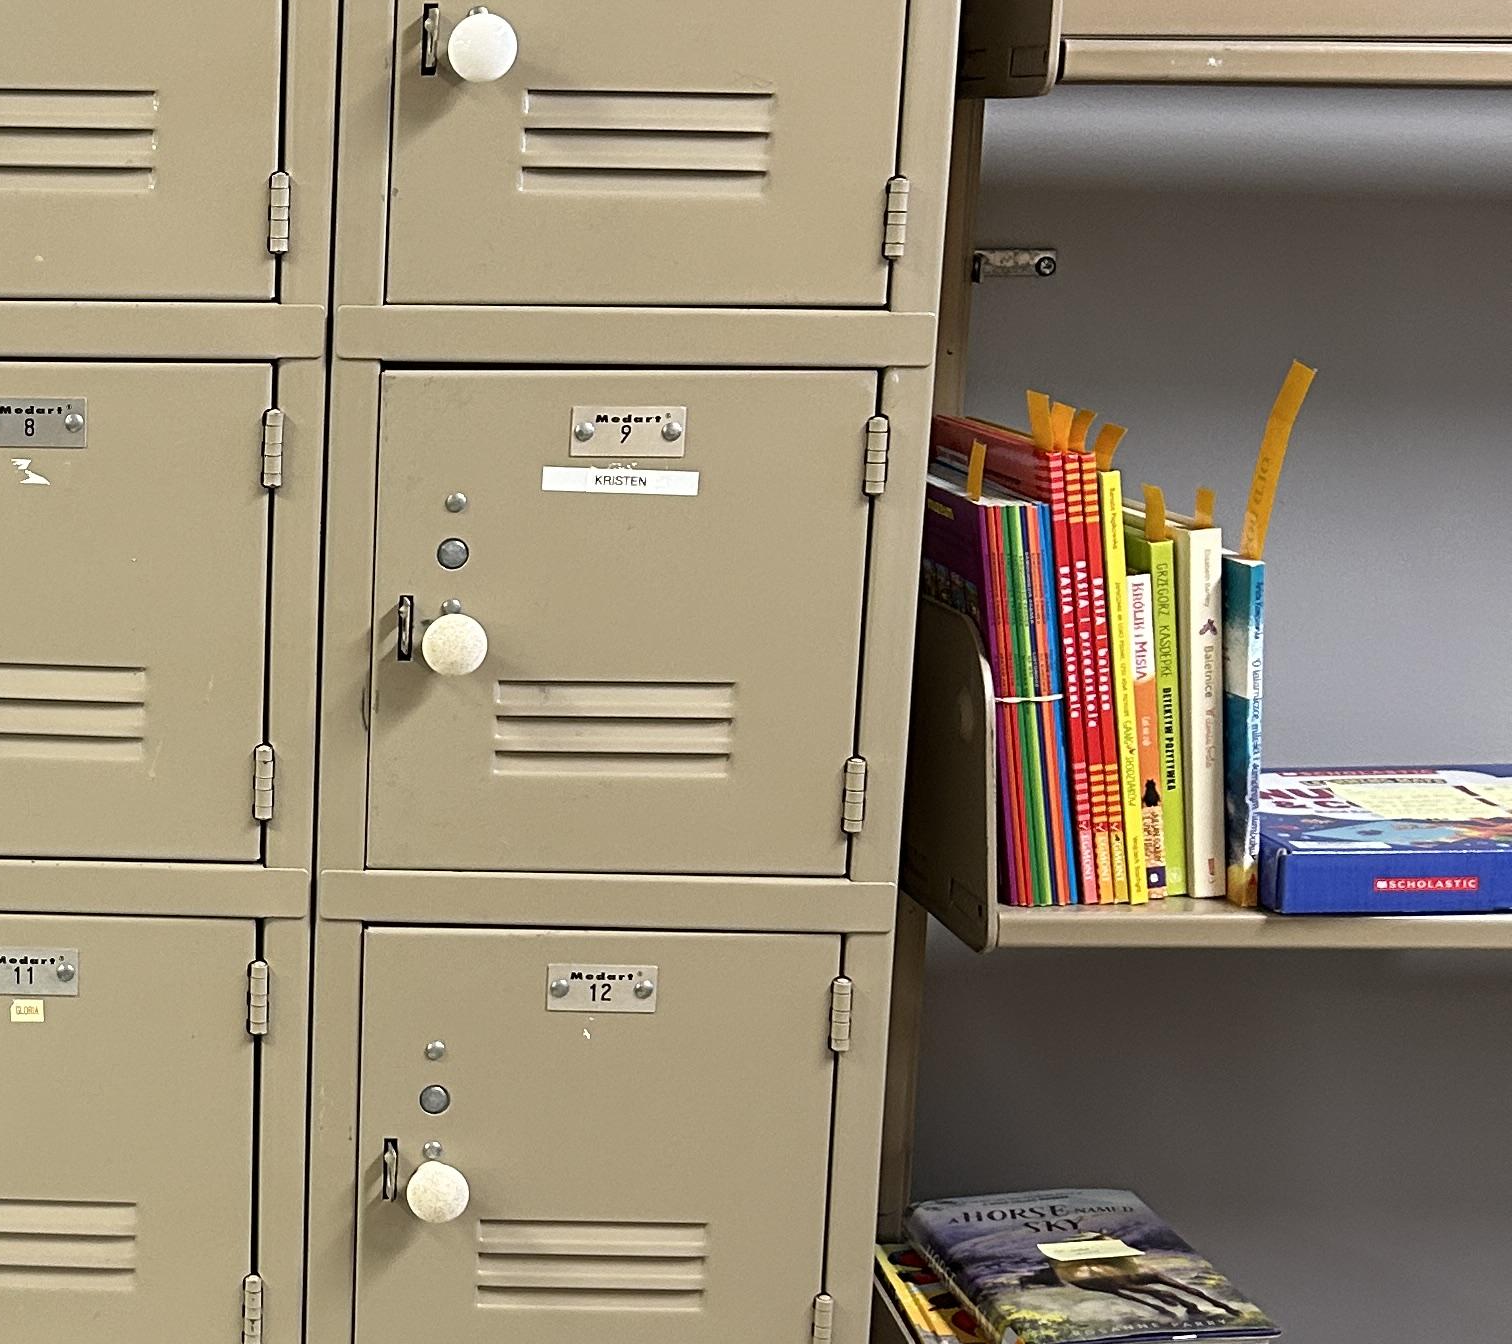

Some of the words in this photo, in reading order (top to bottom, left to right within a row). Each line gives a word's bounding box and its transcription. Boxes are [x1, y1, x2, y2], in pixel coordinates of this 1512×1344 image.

[25, 418, 34, 436] 8
[621, 425, 631, 443] 9
[595, 471, 647, 487] KRISTEN
[1059, 566, 1073, 614] BASIA
[1075, 560, 1089, 609] BASIA
[1092, 578, 1106, 626] BASIA
[1131, 582, 1145, 630] KRÓLIK
[1156, 562, 1170, 616] GRZEGORZ
[1134, 641, 1148, 681] MISIA
[1159, 625, 1172, 678] KASDEPKE
[1204, 645, 1215, 698] Baletnice
[1162, 687, 1173, 734] DETEKTYW
[1164, 737, 1176, 791] POZYTYWKA
[1389, 879, 1477, 890] SCHOLASTIC
[14, 967, 32, 984] 11
[590, 984, 611, 1001] 12
[962, 1205, 1069, 1223] HORSE
[1074, 1206, 1134, 1214] NAMED
[1023, 1216, 1081, 1233] SKY
